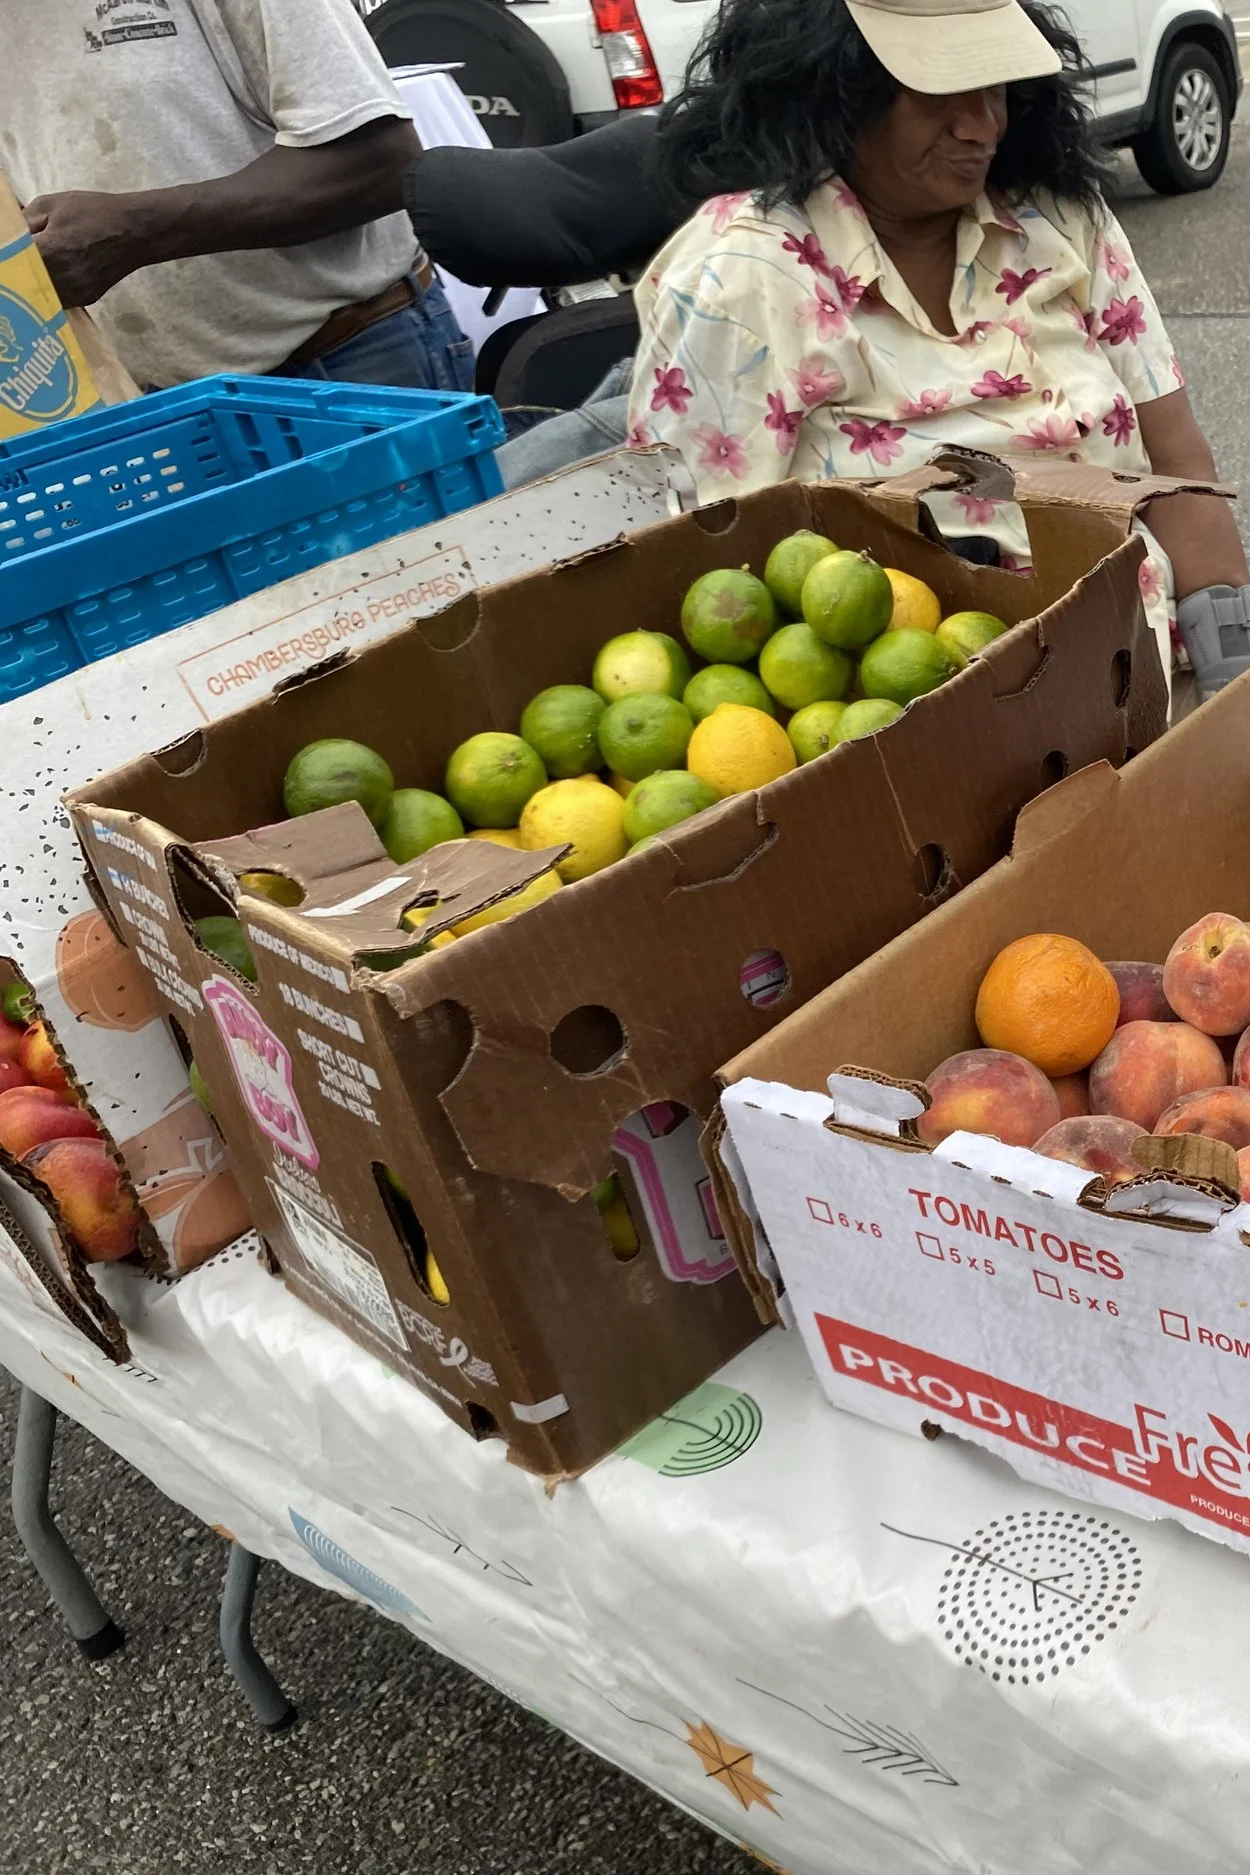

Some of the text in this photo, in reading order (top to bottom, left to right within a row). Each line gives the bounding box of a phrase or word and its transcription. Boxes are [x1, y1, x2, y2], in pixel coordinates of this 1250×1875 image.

[0, 333, 65, 410] Chiquita
[207, 572, 462, 696] CHAMBERSBURG PEACHES
[248, 923, 336, 985] PRODUCE OF MEXICO
[291, 987, 348, 1036] BUNCHES
[297, 1028, 362, 1080] SHORT CUT
[319, 1060, 372, 1105] CROWNS
[908, 1188, 1124, 1280] TOMATOES
[839, 1344, 1152, 1486] PRODUCE
[1190, 1494, 1250, 1527] PRODUCE
